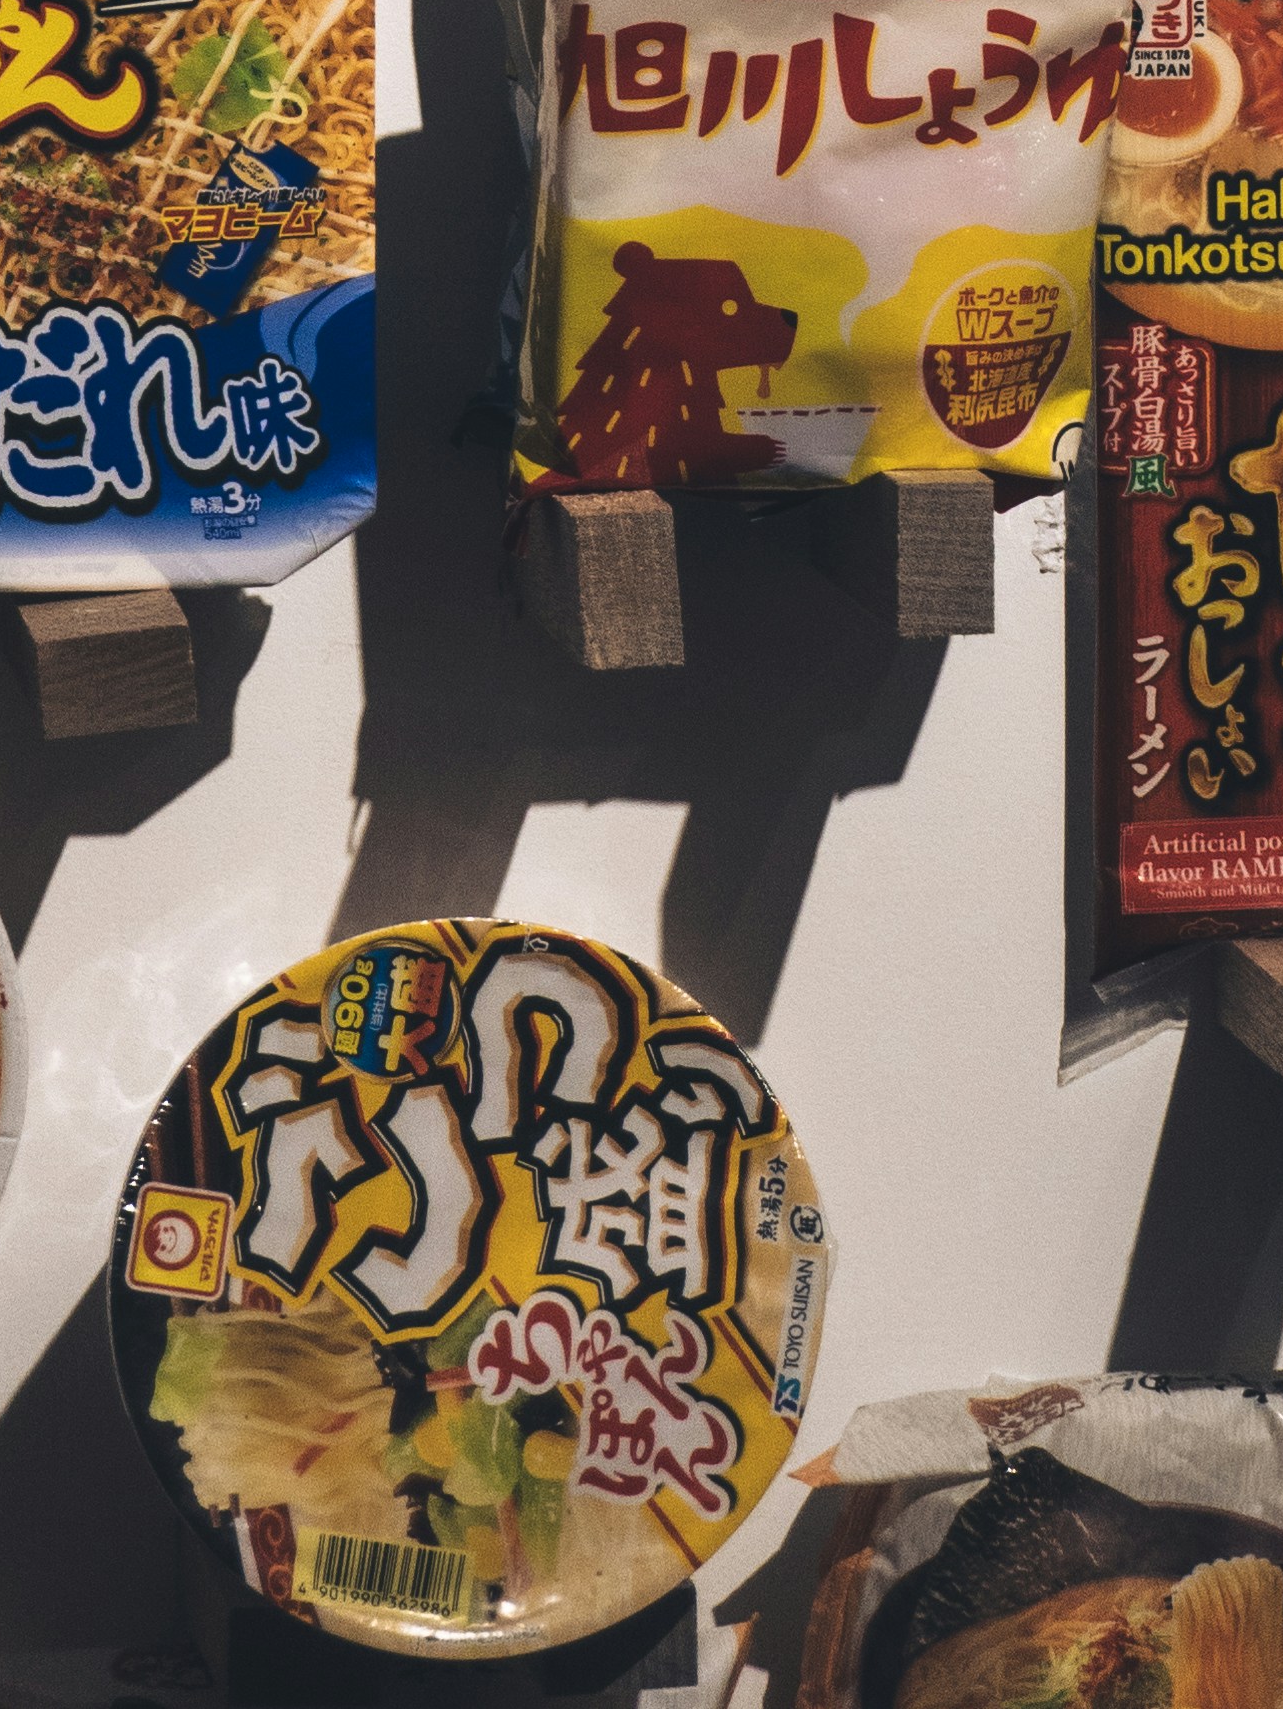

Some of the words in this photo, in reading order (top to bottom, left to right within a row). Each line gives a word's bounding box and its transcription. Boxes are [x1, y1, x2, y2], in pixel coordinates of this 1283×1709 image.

[1135, 62, 1191, 79] JAPAN
[557, 2, 1133, 179] 旭川しょうゆ
[159, 202, 323, 244] マヨビーム
[958, 305, 1059, 342] Wスープ
[188, 482, 263, 516] 熱湯3分
[1127, 635, 1172, 799] ラーメン
[1143, 831, 1246, 856] Artificial
[1137, 861, 1204, 884] flavor
[787, 1258, 815, 1318] SUISAN
[782, 1319, 810, 1370] TOYO
